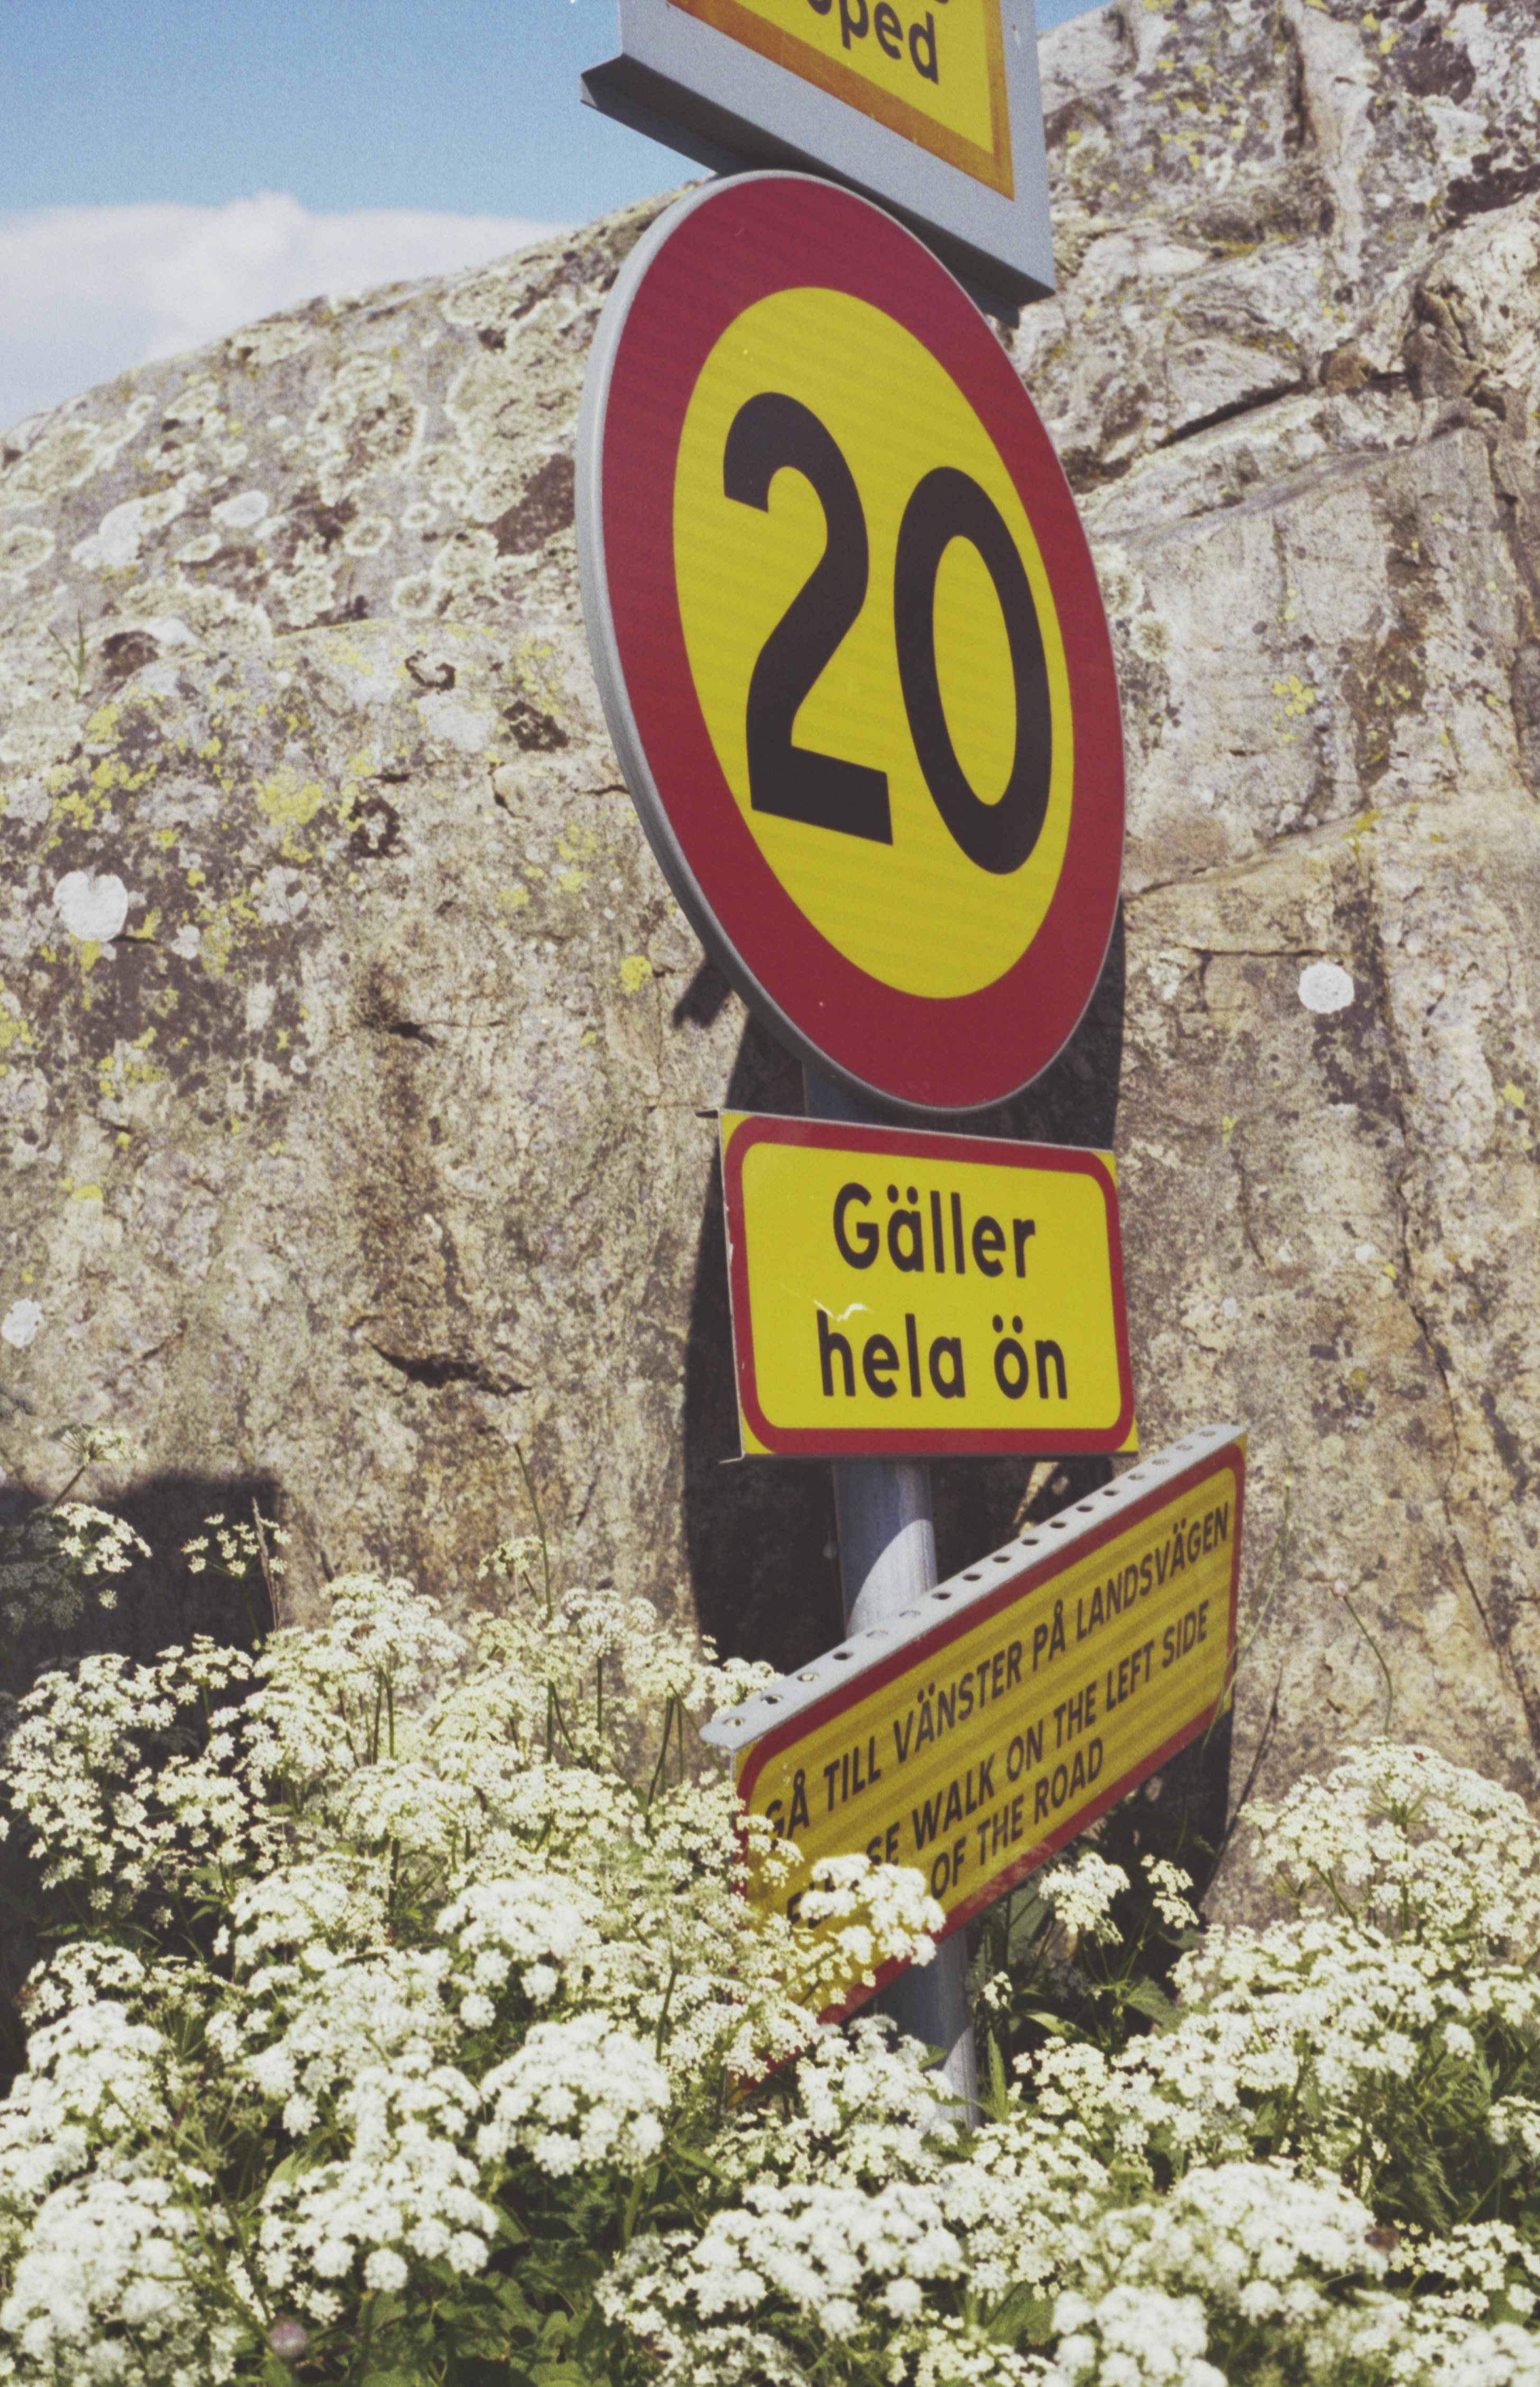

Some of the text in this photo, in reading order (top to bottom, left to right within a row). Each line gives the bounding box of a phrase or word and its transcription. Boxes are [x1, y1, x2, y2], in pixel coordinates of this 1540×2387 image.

[806, 0, 939, 86] ped
[722, 391, 1053, 875] 20
[833, 1182, 1036, 1278] Gäller
[817, 1309, 1068, 1400] hela ön
[823, 1736, 881, 1812] TILL
[893, 1640, 1022, 1764] VÄNSTER
[1033, 1599, 1066, 1672] PÅ
[1076, 1501, 1229, 1641] LANDSVÄGEN
[912, 1752, 995, 1851] WALK
[1006, 1719, 1043, 1783] ON
[1053, 1681, 1097, 1749] THE
[1106, 1640, 1154, 1712] LEFT
[1162, 1600, 1209, 1669] SIDE
[931, 1737, 1104, 1900] OF THE ROAD
